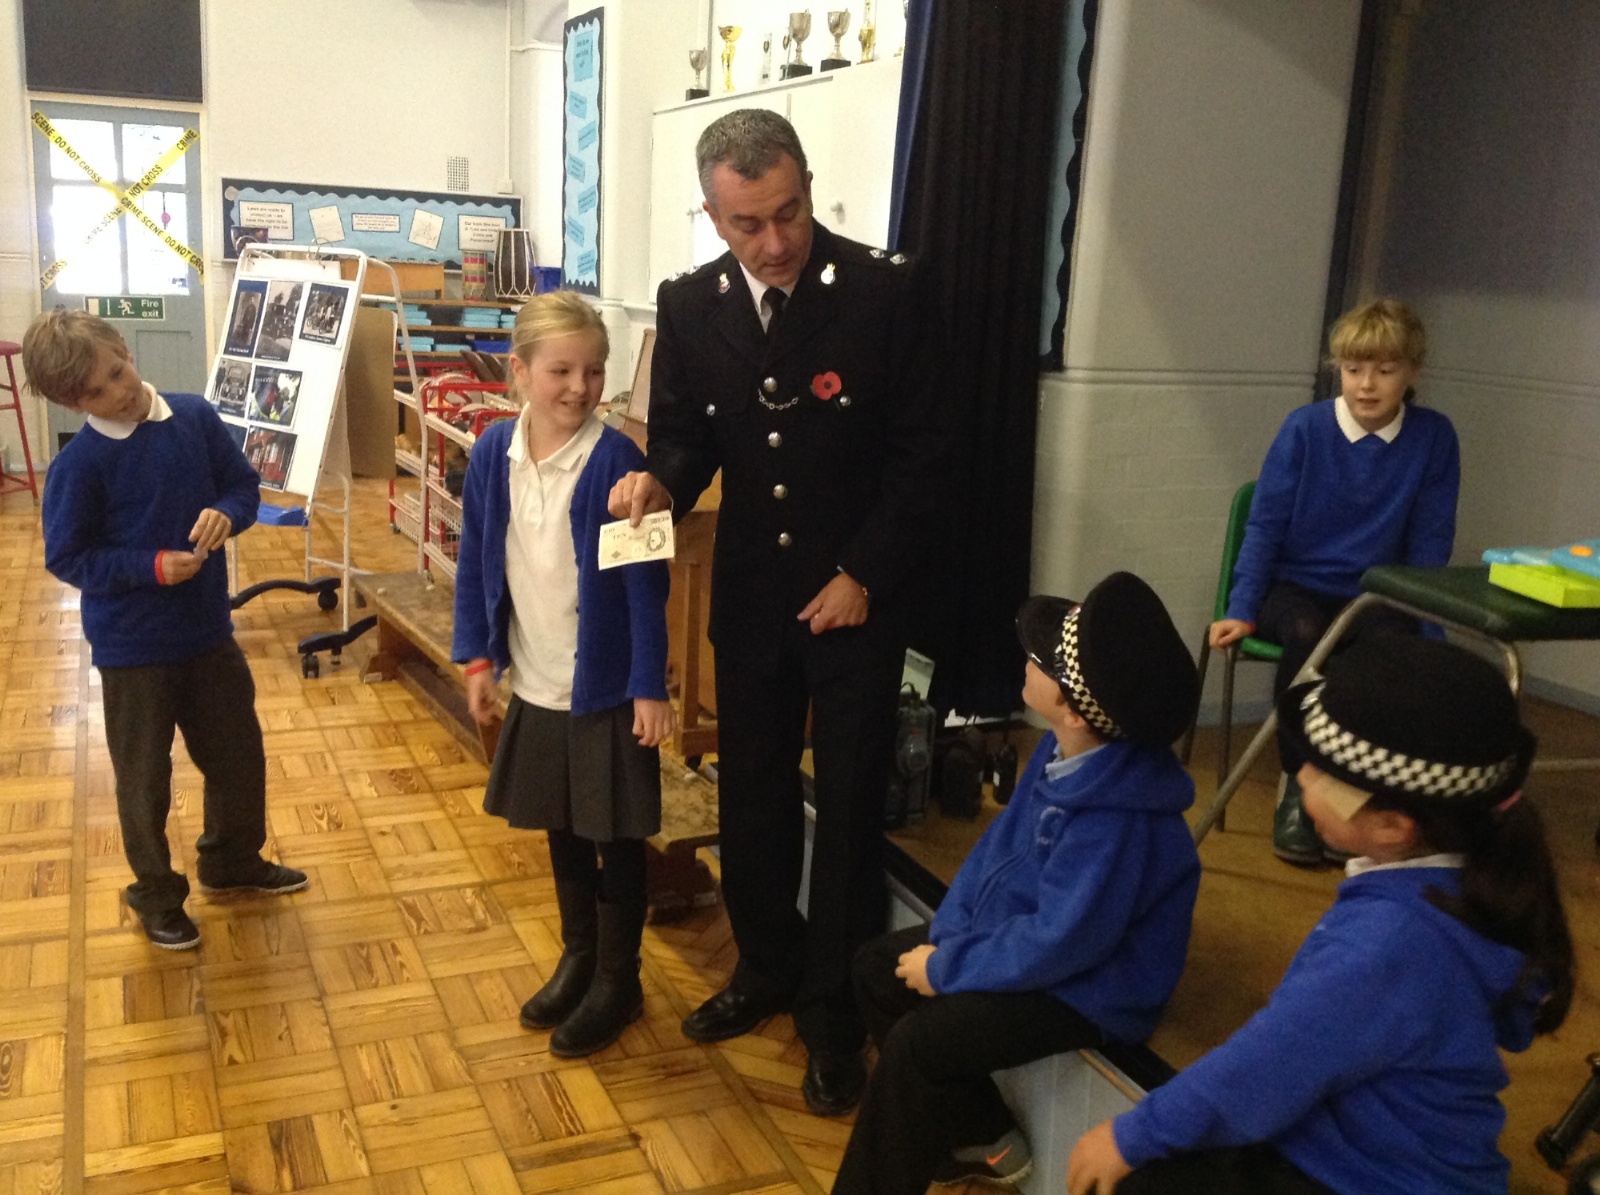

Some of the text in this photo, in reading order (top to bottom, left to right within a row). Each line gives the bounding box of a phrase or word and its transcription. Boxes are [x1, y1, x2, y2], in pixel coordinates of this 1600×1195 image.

[31, 112, 55, 136] SCENE
[55, 136, 66, 148] DO
[65, 146, 80, 161] NOT
[79, 161, 102, 183] CROSS
[121, 197, 143, 218] CRIME
[142, 216, 164, 236] SCENE
[165, 236, 176, 248] DO
[175, 244, 191, 258] NOT
[45, 260, 67, 280] CROSS
[101, 207, 122, 227] SCENE
[128, 182, 144, 198] NOT
[141, 164, 163, 186] CROSS
[176, 130, 197, 151] CRIME
[141, 299, 159, 308] Fire
[141, 310, 159, 318] exit
